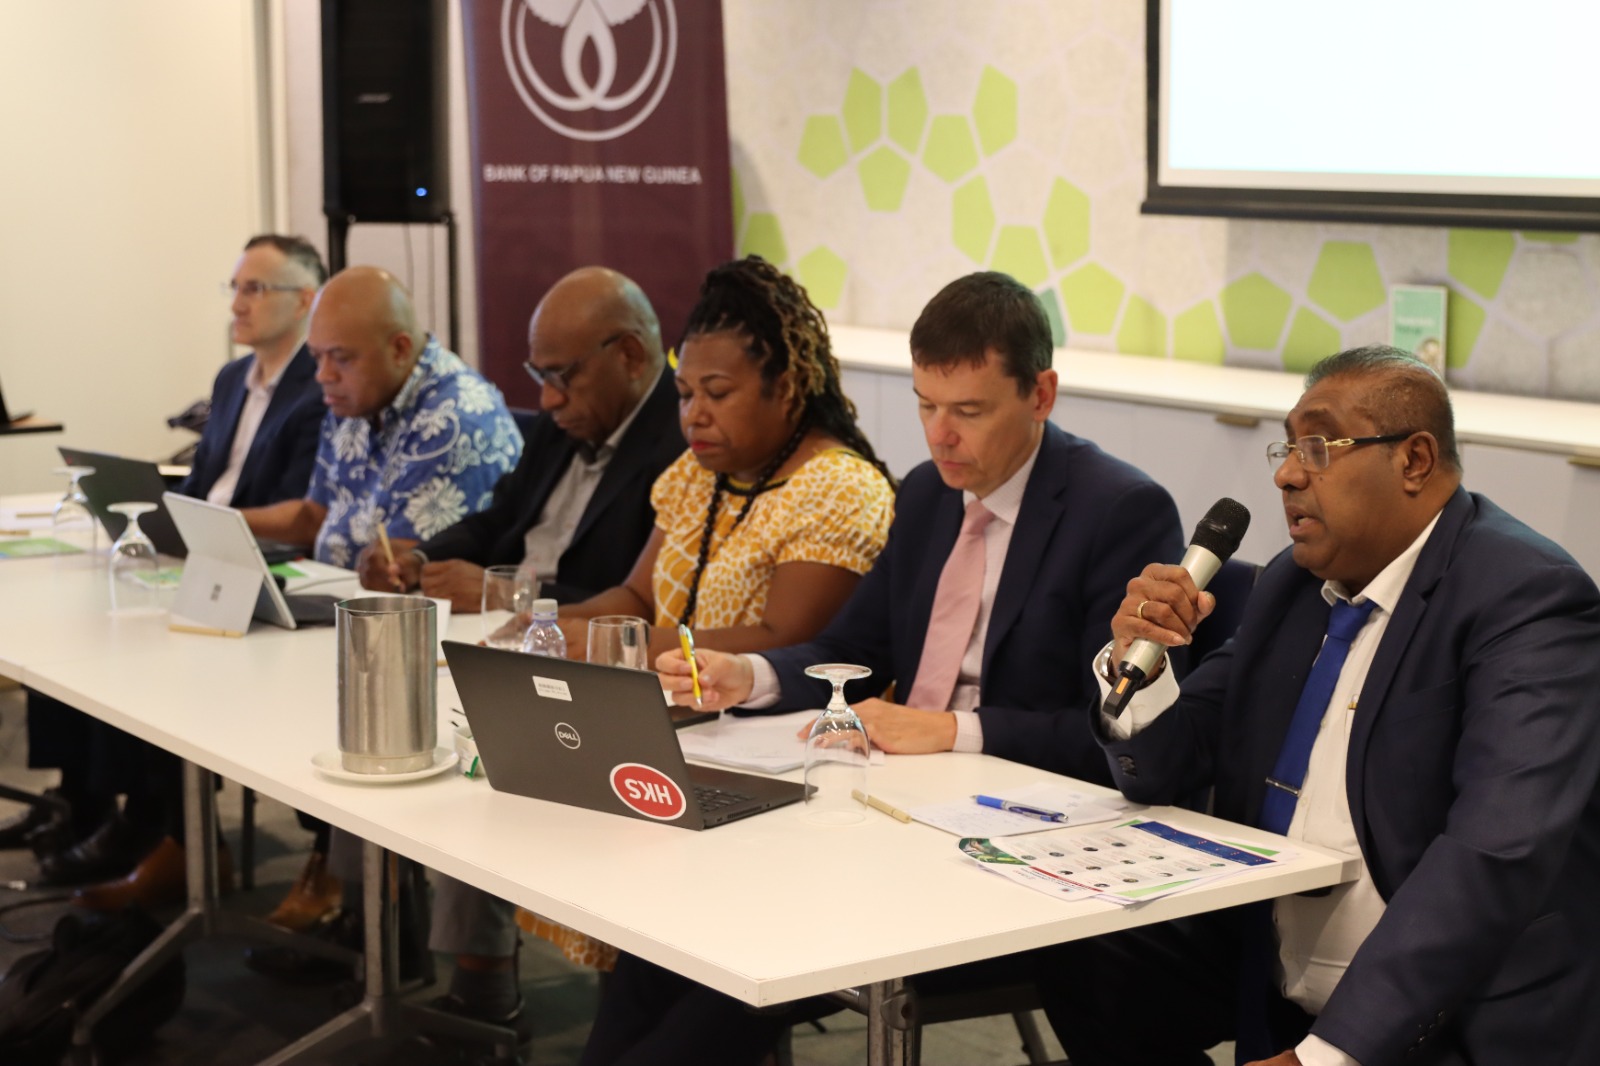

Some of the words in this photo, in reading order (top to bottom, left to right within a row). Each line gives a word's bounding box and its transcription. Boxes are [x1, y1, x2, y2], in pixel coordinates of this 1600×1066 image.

[483, 164, 527, 183] BANK
[528, 164, 549, 183] OF
[551, 164, 605, 183] PAPUA
[605, 165, 640, 184] NEW
[641, 165, 702, 184] GUINEA
[558, 731, 578, 741] DELL
[624, 778, 673, 806] HKS
